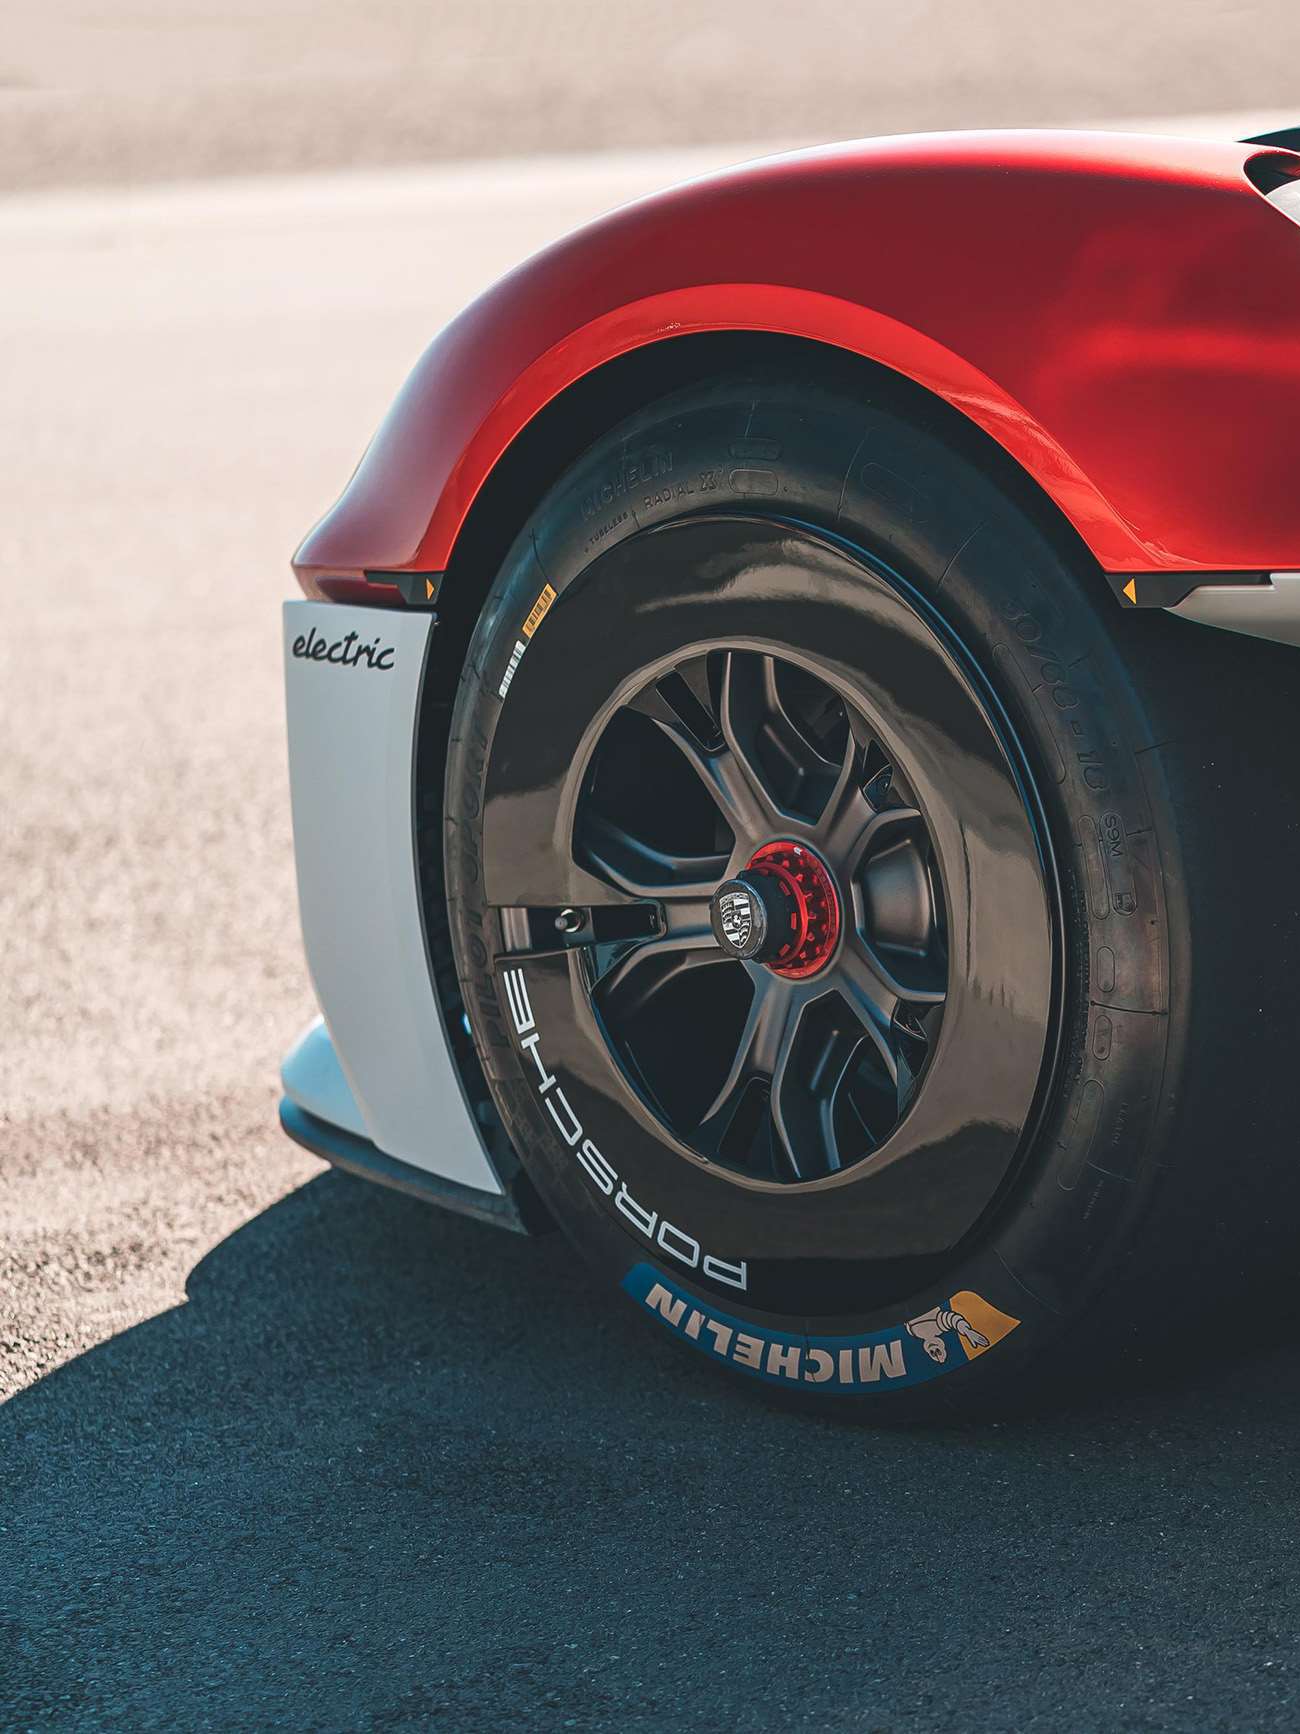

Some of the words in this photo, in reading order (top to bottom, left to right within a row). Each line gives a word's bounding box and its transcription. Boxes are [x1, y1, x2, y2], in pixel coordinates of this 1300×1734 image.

[643, 485, 695, 511] RADIAL
[292, 626, 396, 671] electric
[503, 968, 747, 1290] PORSCHE
[645, 1283, 907, 1384] MICHELIN
